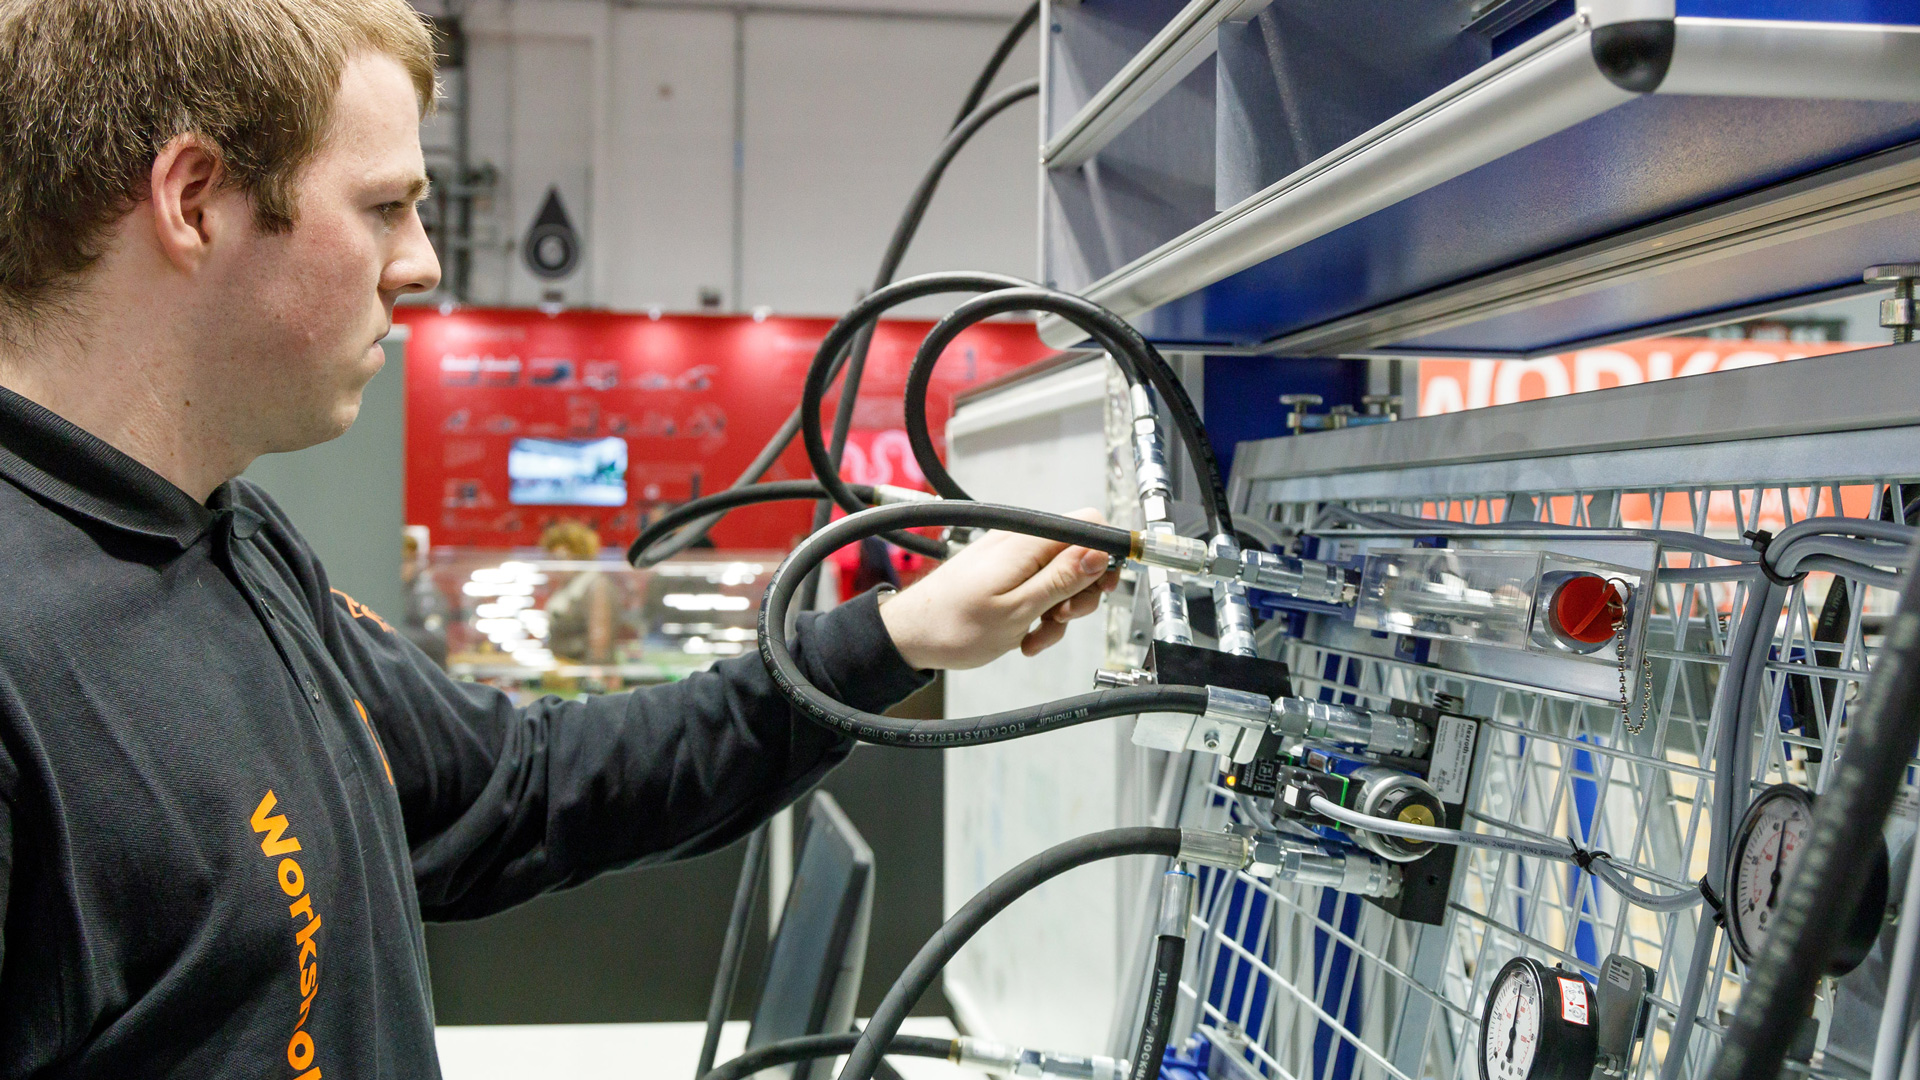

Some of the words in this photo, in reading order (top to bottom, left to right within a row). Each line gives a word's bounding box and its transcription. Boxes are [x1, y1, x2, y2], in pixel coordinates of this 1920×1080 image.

[790, 691, 805, 708] SAE
[808, 704, 825, 719] 2SC
[840, 719, 853, 731] EN
[909, 722, 1026, 743] ROCKMASTER/2SC
[882, 729, 897, 741] ISO
[1462, 724, 1474, 754] Rexroth
[1135, 1035, 1155, 1080] ROCKM
